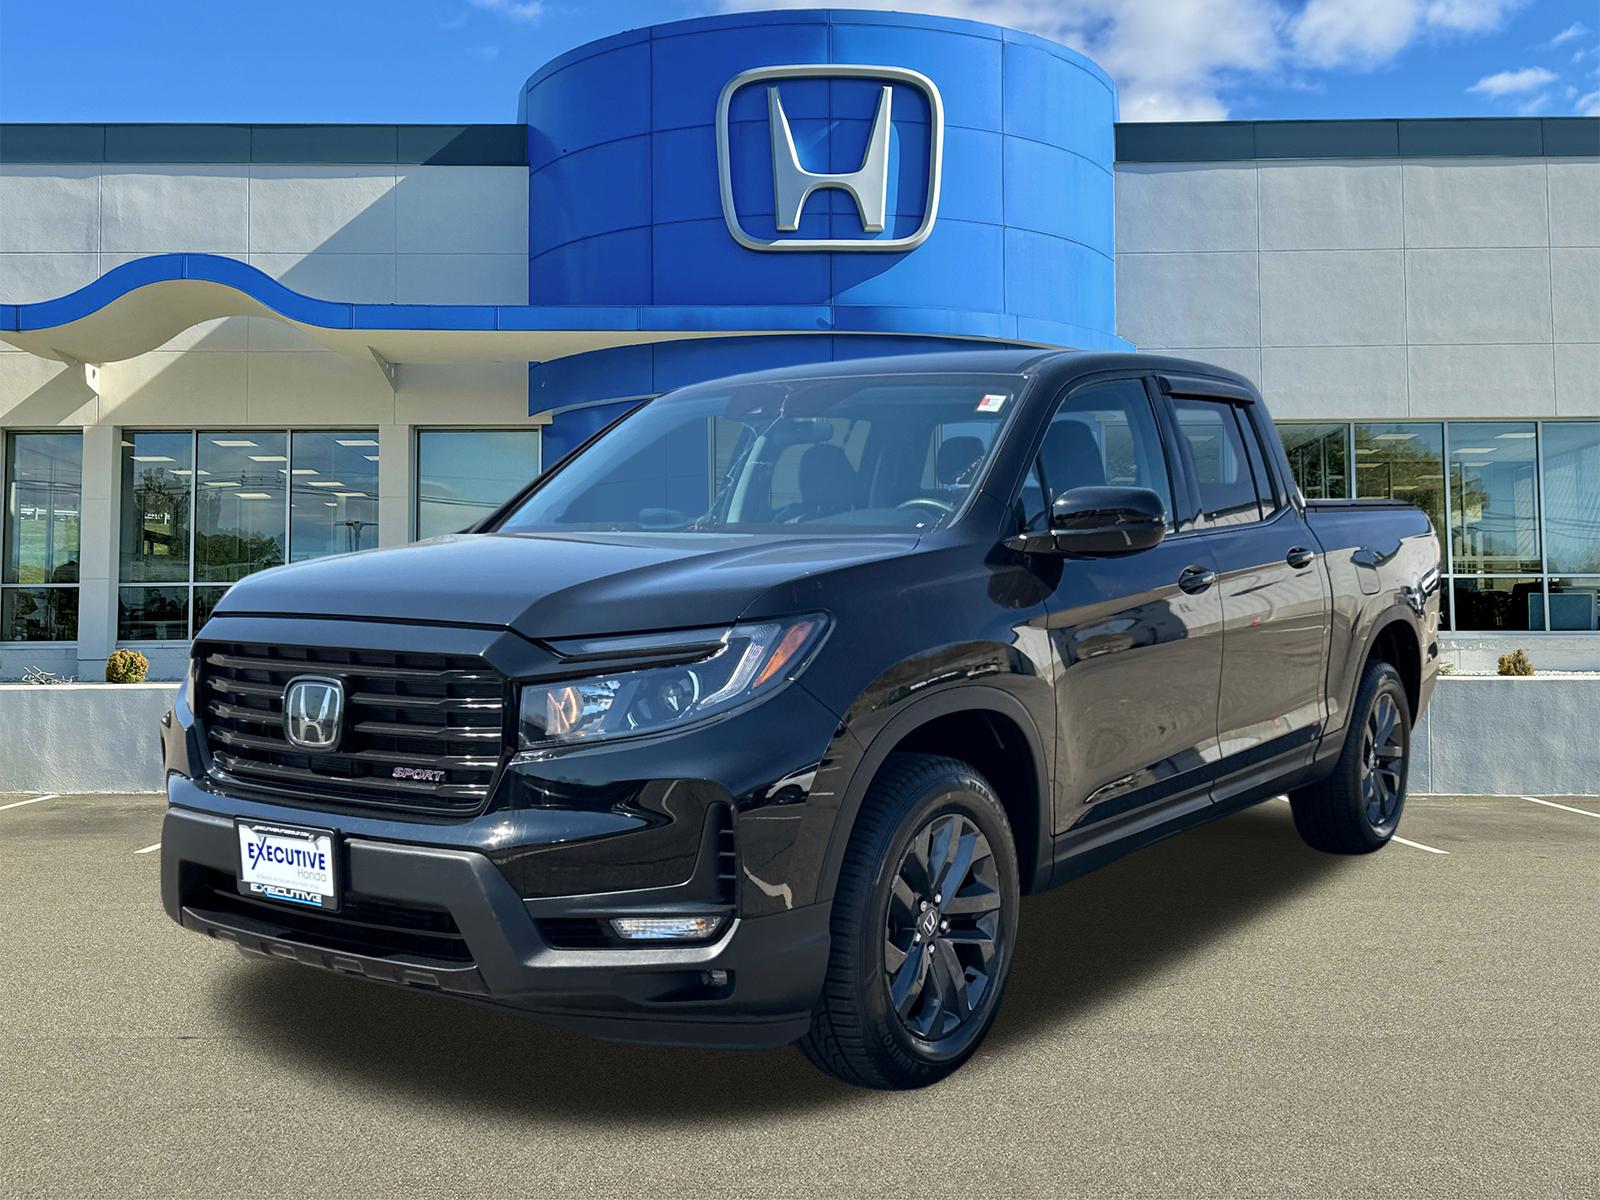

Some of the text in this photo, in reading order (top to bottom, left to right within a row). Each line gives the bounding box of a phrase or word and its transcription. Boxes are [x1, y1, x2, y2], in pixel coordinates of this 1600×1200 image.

[392, 766, 445, 781] SPORT
[247, 836, 326, 870] EXECUTIVE
[297, 867, 327, 883] Honda
[250, 882, 322, 904] EXECUTIVE
